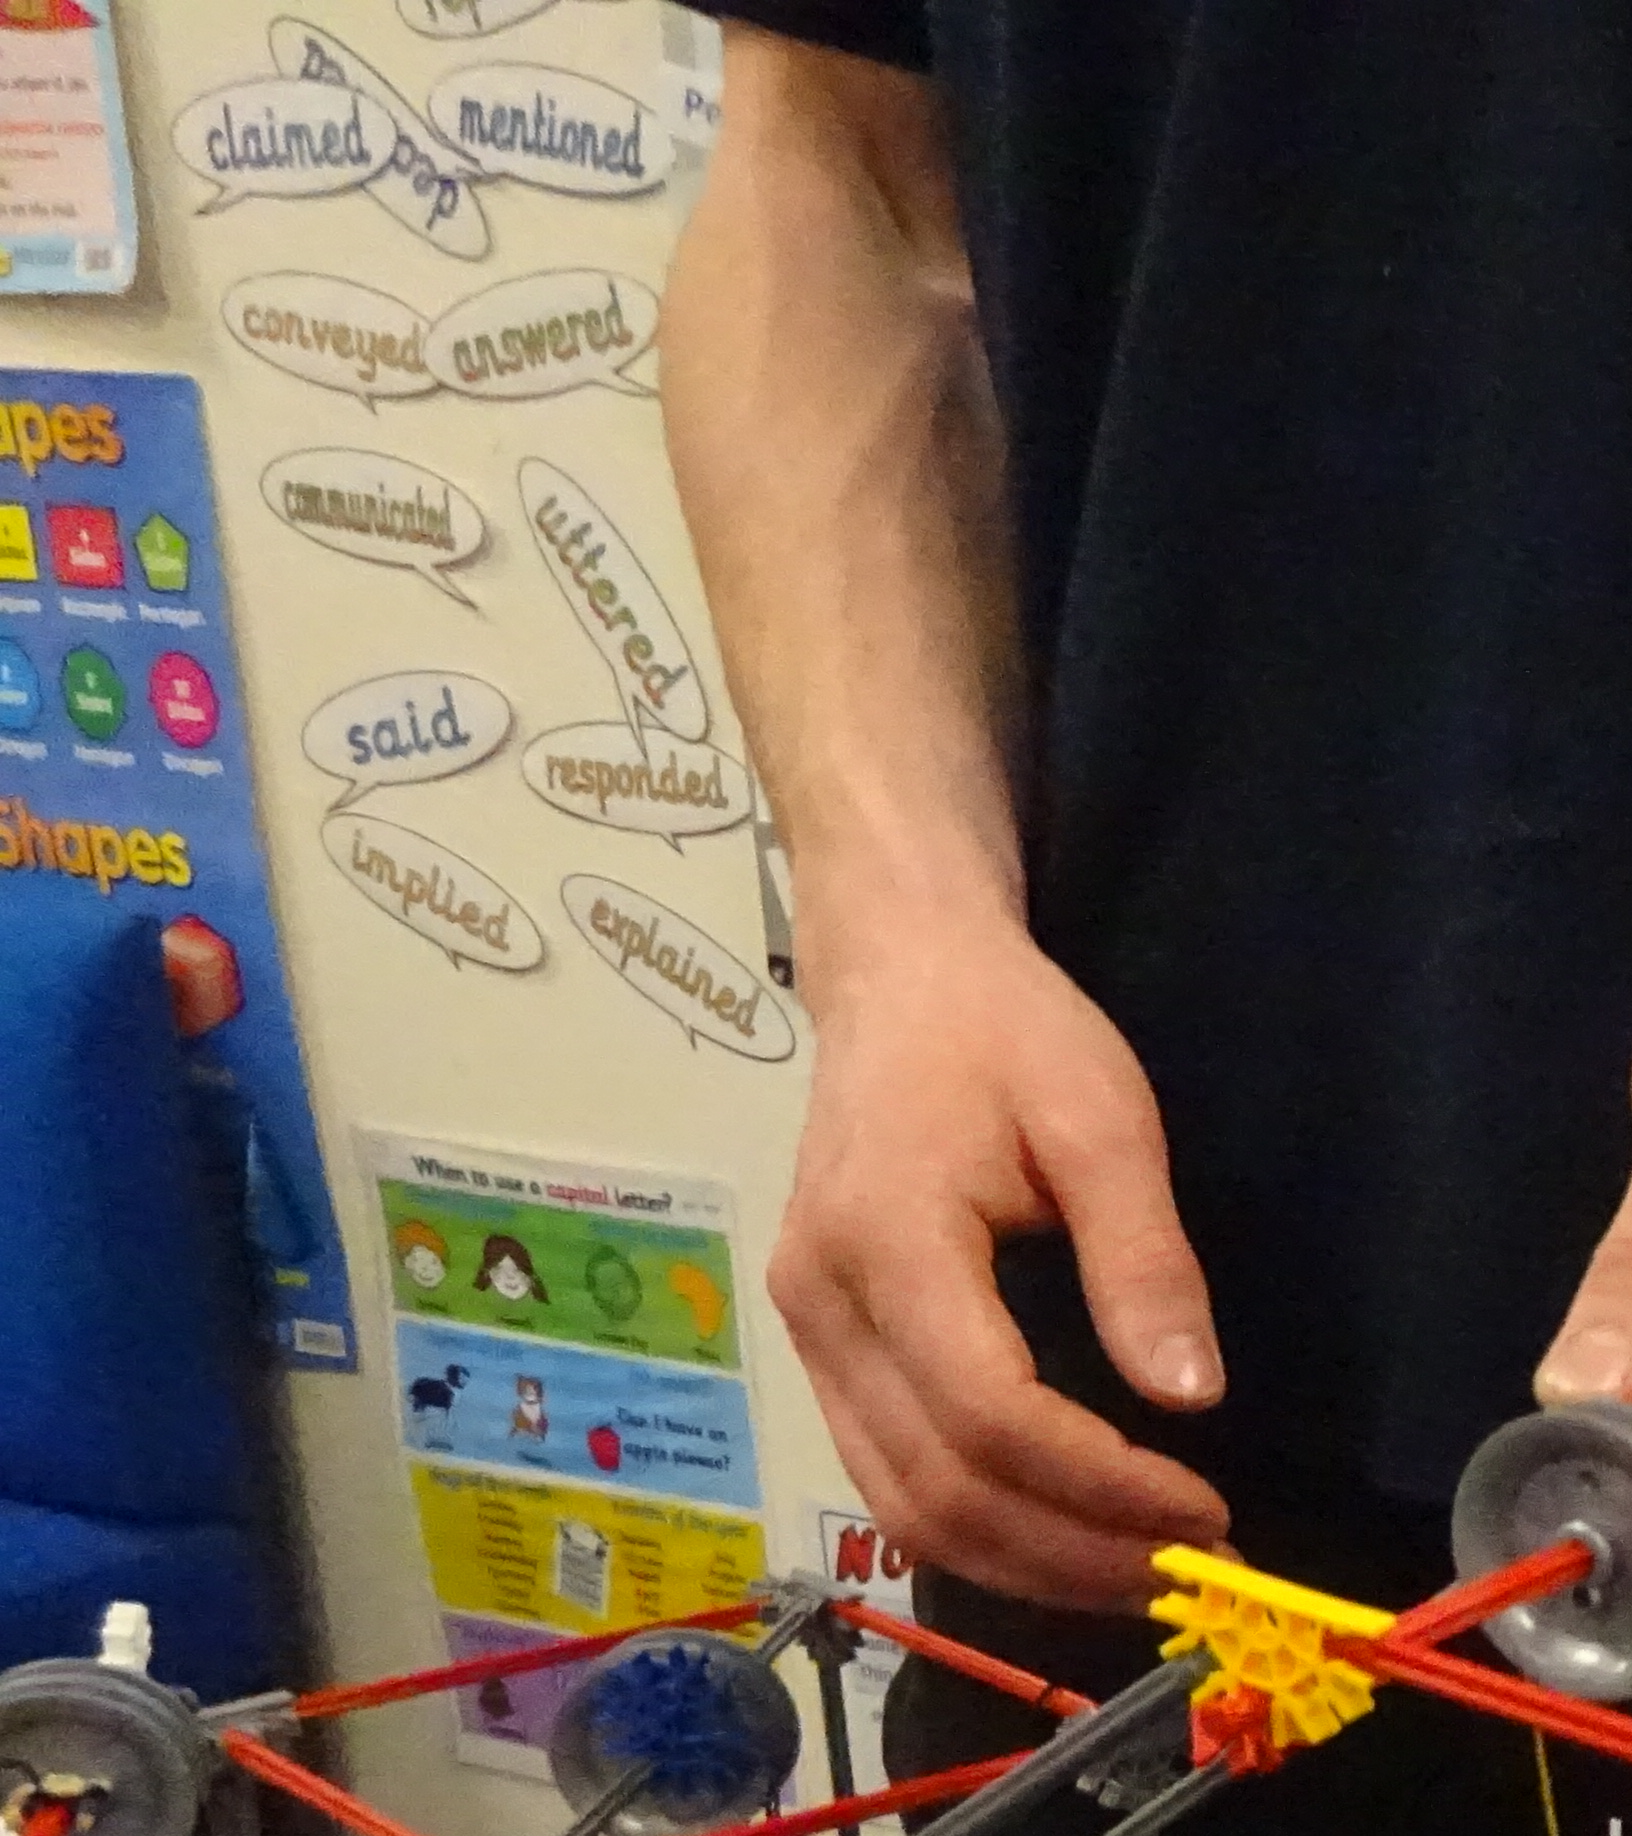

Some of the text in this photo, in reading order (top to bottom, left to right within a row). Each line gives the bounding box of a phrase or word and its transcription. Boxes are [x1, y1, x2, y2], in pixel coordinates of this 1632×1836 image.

[207, 93, 372, 172] claimed
[459, 91, 646, 178] mentioned
[243, 303, 428, 383] conveyed
[453, 279, 635, 382] answered
[282, 479, 457, 552] communicated
[534, 495, 689, 711] uttered
[347, 686, 471, 766] said
[545, 750, 730, 816] responded
[352, 829, 511, 952] implied
[590, 898, 758, 1039] explained
[411, 1155, 469, 1185] When
[470, 1169, 491, 1188] to
[529, 1180, 542, 1196] a
[547, 1182, 608, 1211] capital
[614, 1185, 673, 1215] letter?
